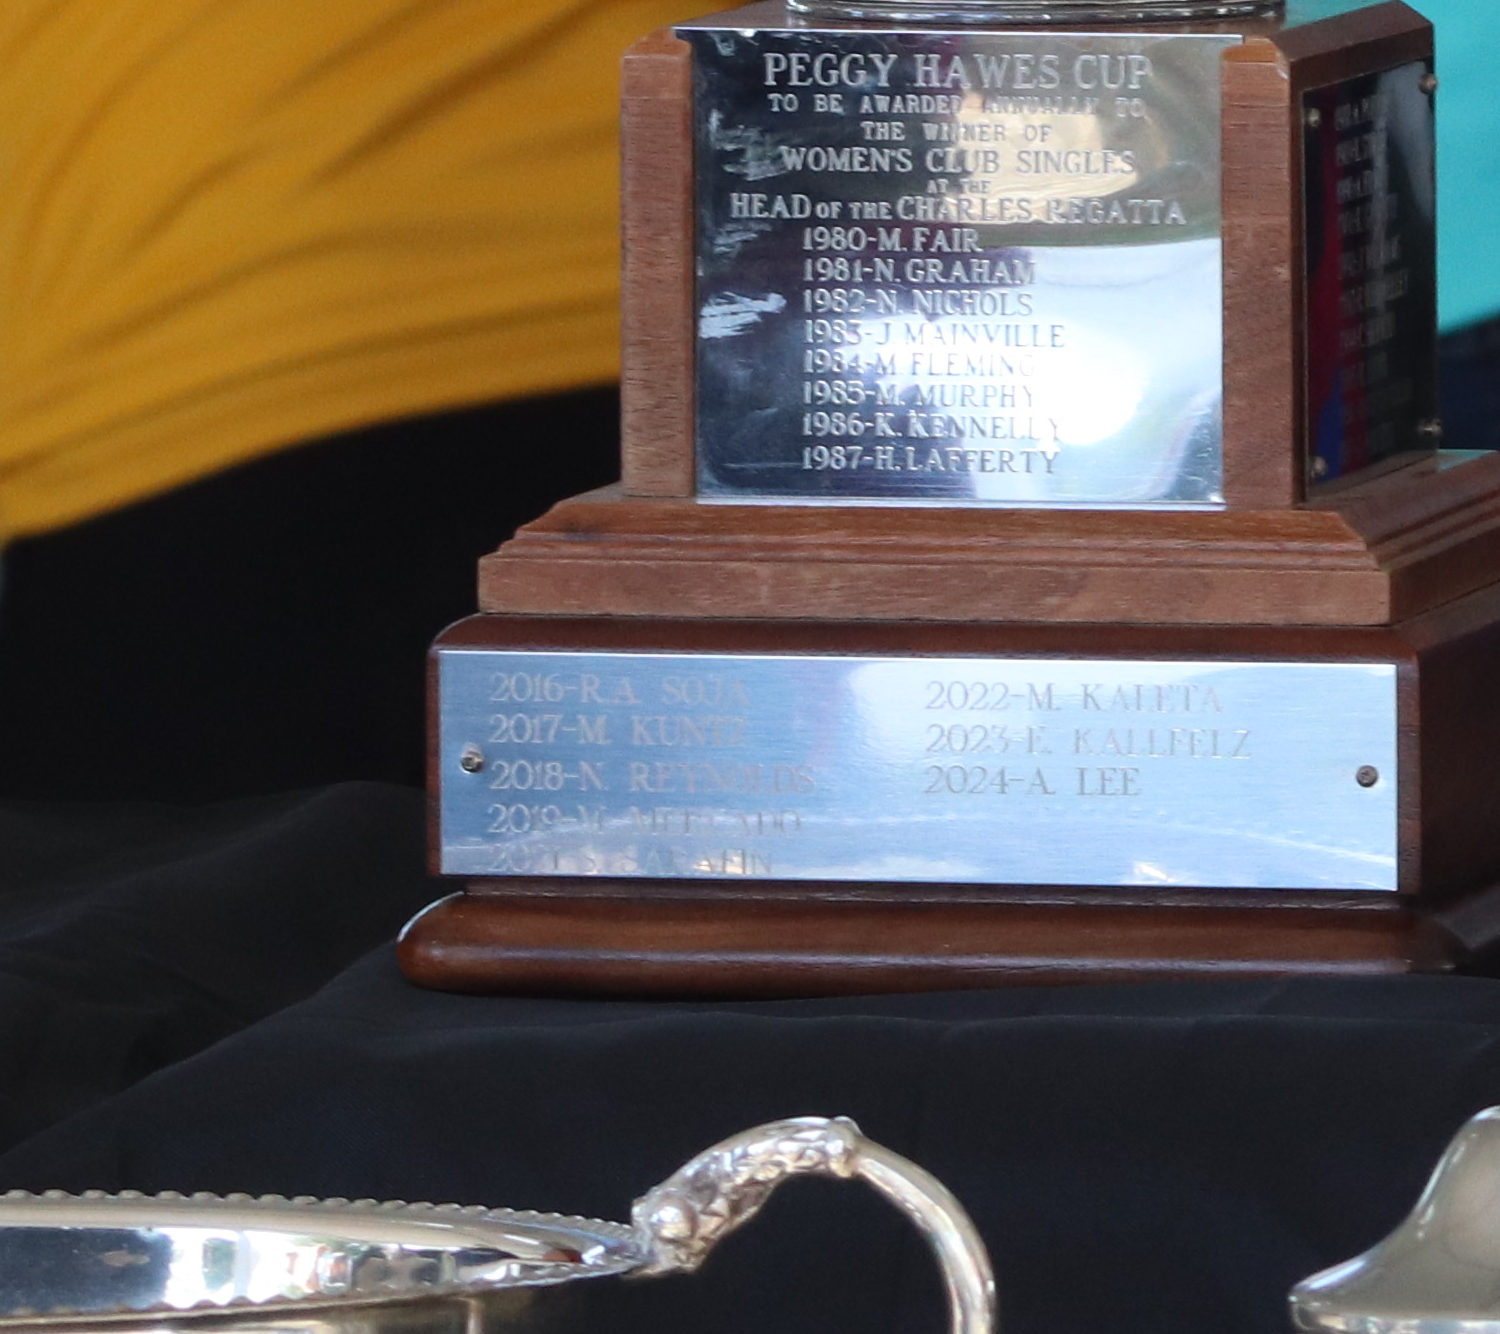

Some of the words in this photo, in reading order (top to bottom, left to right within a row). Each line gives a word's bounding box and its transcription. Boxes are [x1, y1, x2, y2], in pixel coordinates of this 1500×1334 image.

[764, 53, 897, 88] PEGGY
[914, 54, 1061, 90] HAWES
[1074, 54, 1154, 90] CUP
[768, 93, 798, 113] TO
[813, 94, 844, 114] BE
[859, 94, 962, 114] AWARDED
[982, 95, 1099, 115] ANNUALLY
[1115, 97, 1146, 118] TO
[861, 122, 905, 141] THE
[923, 122, 1008, 142] WINNER
[1024, 124, 1054, 142] OF
[780, 148, 913, 173] WOMEN'S
[926, 149, 1000, 174] CLUB
[1016, 150, 1137, 175] SINGLES
[927, 180, 948, 194] AT
[960, 180, 991, 194] THE
[731, 193, 812, 219] HEAD
[818, 203, 844, 219] OF
[850, 203, 893, 220] THE
[896, 195, 1034, 222] CHARLES
[1045, 199, 1187, 226] REGATTA
[803, 228, 906, 252] 1980-M.
[913, 228, 984, 253] FAIR
[803, 259, 900, 283] 1981-N.
[905, 259, 1037, 284] GRAHAM
[803, 290, 902, 315] 1982-N.
[912, 291, 1033, 316] NICHOLS
[903, 323, 1067, 348] MAINVILLE
[910, 352, 1035, 377] FLEMING
[916, 383, 1036, 408] MURPHY
[803, 412, 903, 436] 1986-K.
[909, 413, 1060, 440] KENNELLY
[803, 447, 902, 471] 1987-H.
[905, 448, 1059, 474] LAFFERTY
[925, 680, 1062, 712] 2022-M.
[1081, 681, 1222, 714] KALETA
[488, 713, 611, 744] 2017-M.
[631, 716, 747, 747] KUNTZ
[1074, 728, 1253, 759] KALLFELZ
[1076, 767, 1142, 797] LEE
